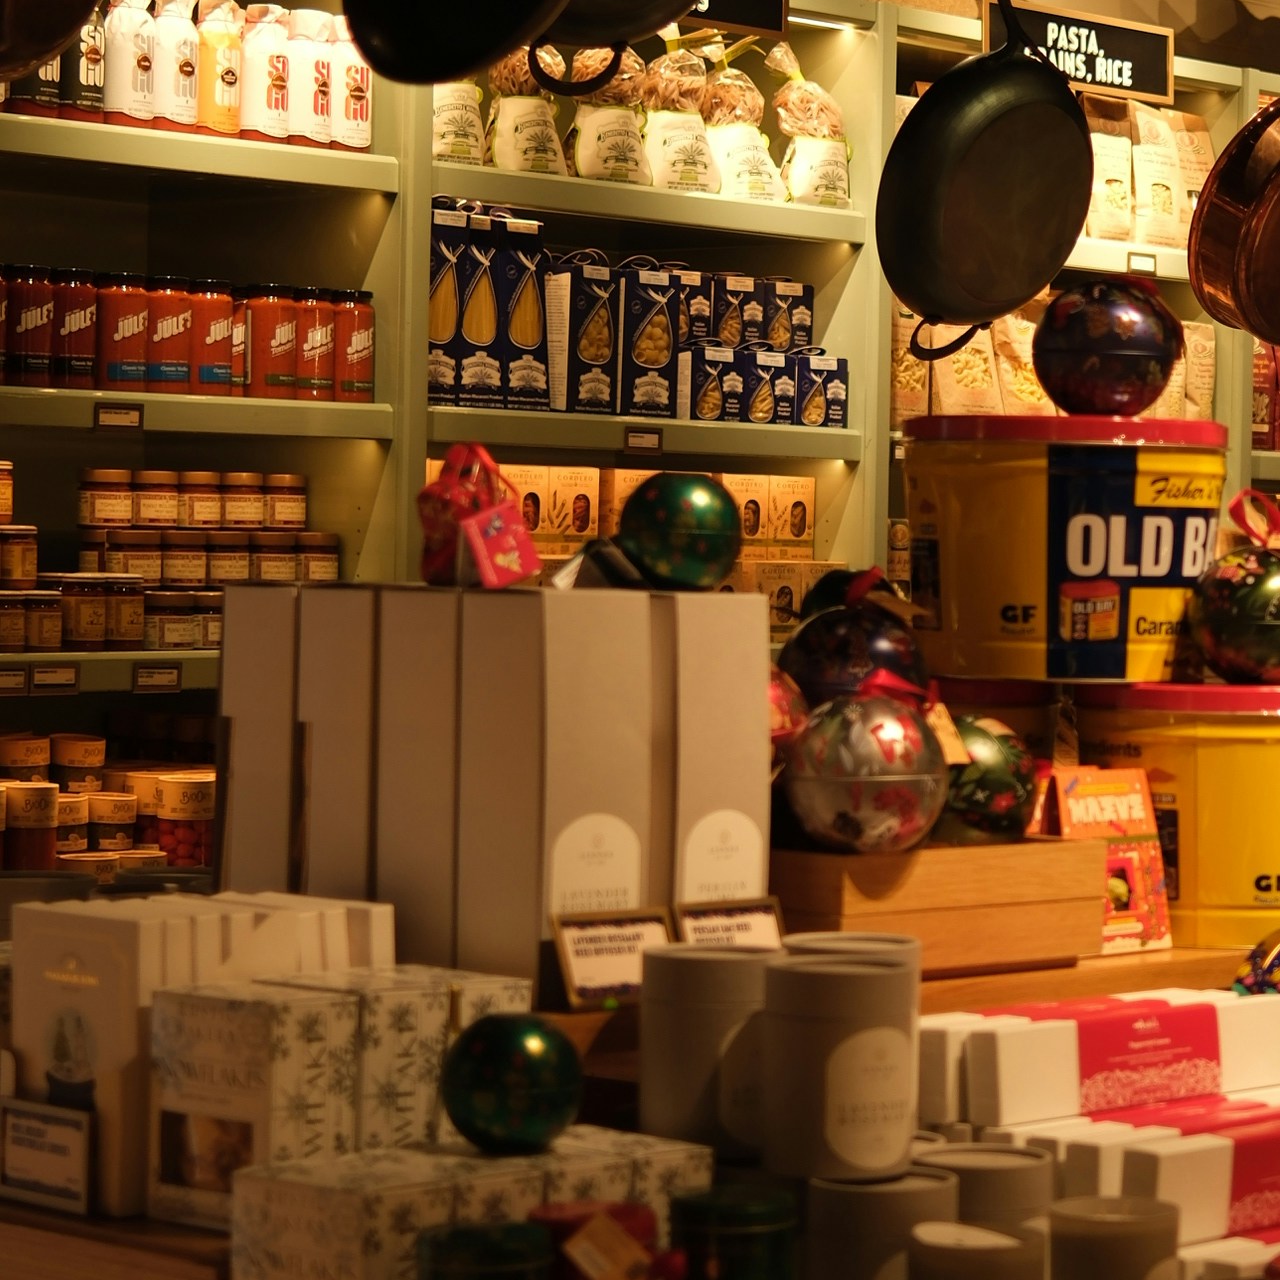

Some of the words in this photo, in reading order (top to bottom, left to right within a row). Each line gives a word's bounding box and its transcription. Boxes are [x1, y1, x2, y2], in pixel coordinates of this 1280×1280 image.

[1046, 21, 1105, 57] PASTA,
[1095, 55, 1133, 87] RICE
[1065, 513, 1174, 578] OLD
[1000, 605, 1037, 623] GF
